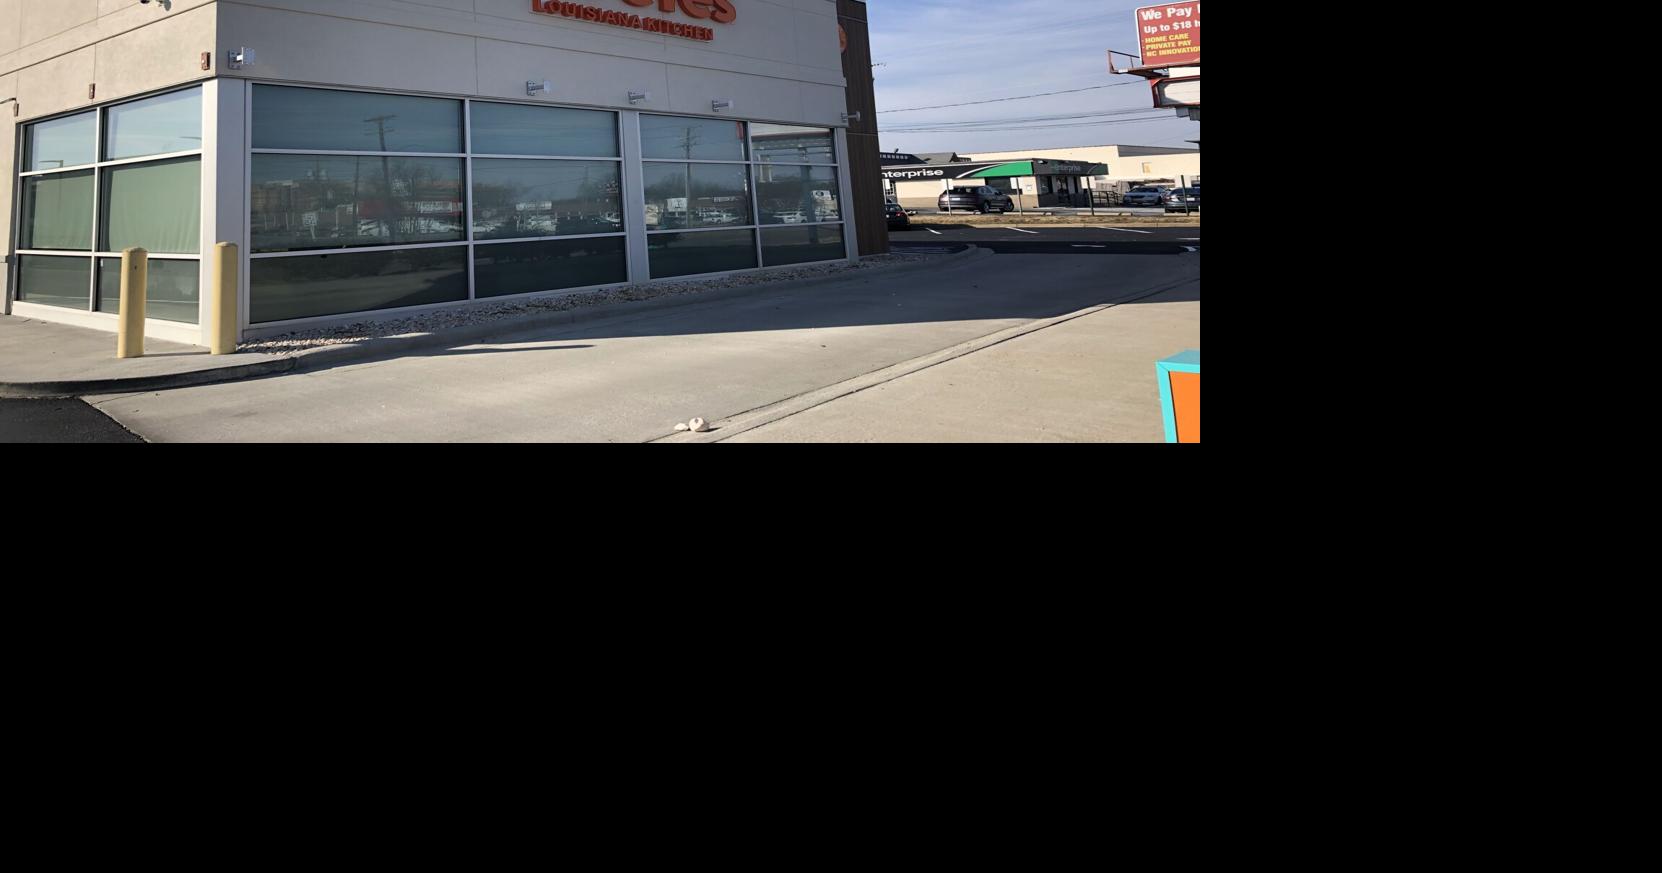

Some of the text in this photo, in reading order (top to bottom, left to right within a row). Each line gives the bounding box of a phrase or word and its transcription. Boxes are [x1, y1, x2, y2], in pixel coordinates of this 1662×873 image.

[532, 0, 714, 41] LOUISIANA KITCHEN
[1141, 9, 1162, 21] We
[1167, 7, 1192, 18] Pay
[1144, 25, 1158, 34] Up
[1172, 20, 1192, 30] $18
[1168, 32, 1189, 41] CARE
[1145, 39, 1192, 50] PRIVATE PAY
